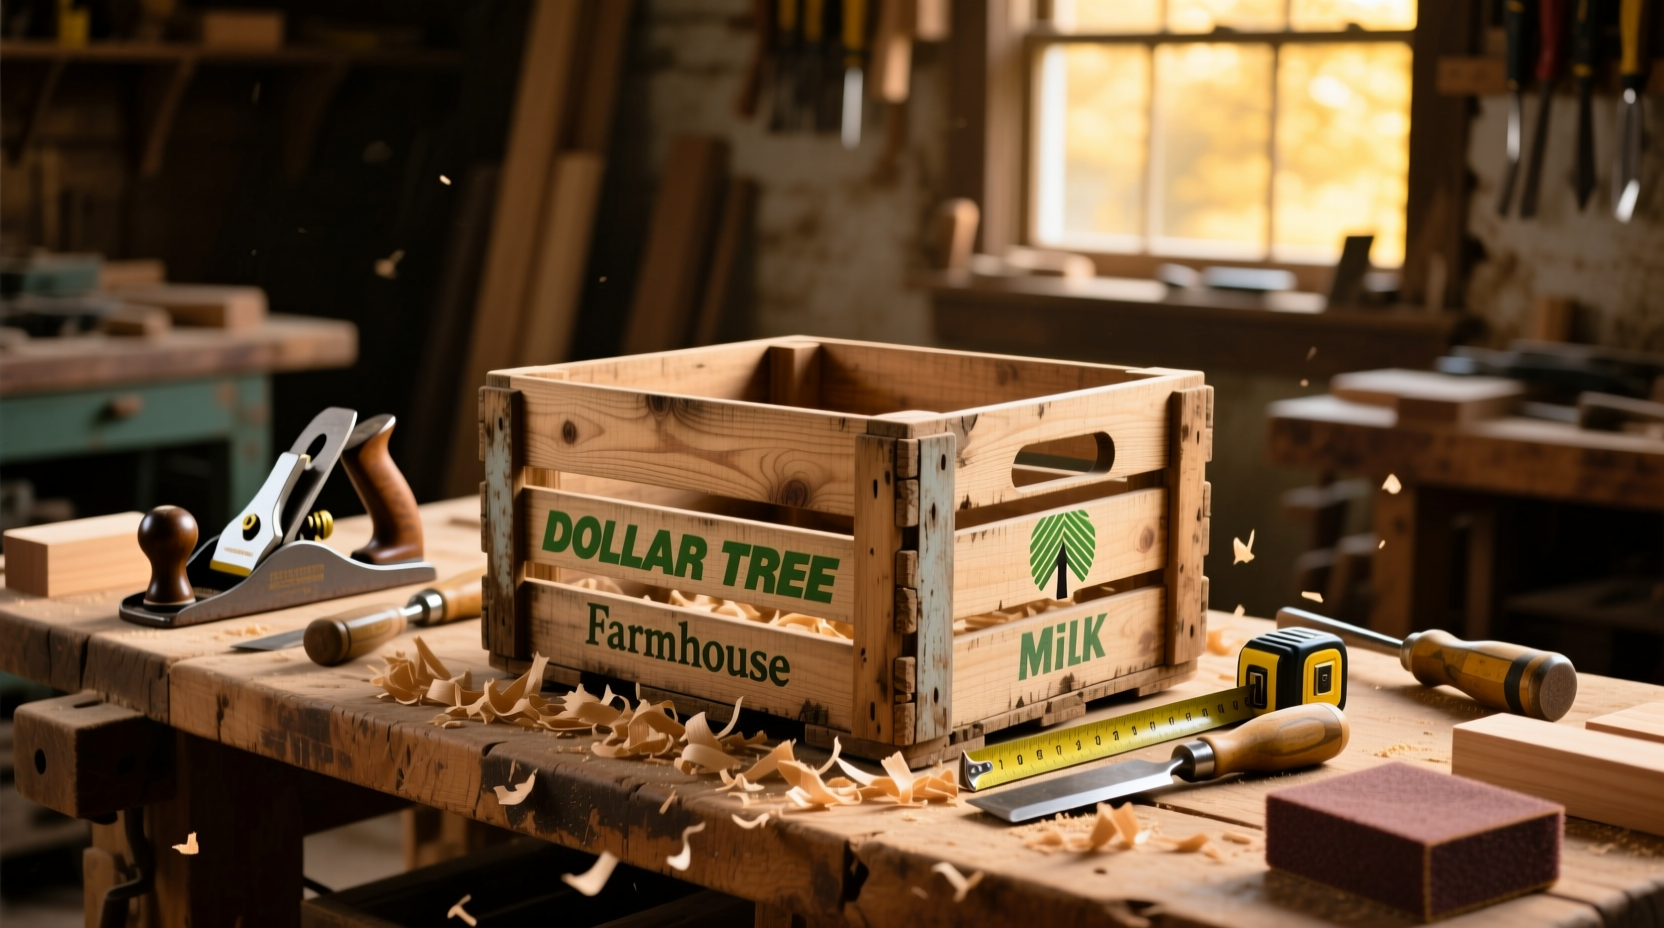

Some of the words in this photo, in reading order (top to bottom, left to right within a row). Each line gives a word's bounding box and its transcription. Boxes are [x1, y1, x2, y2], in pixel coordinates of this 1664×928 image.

[542, 509, 708, 581] DOLLAR
[721, 540, 841, 604] TREE
[585, 602, 791, 687] Farmhouse
